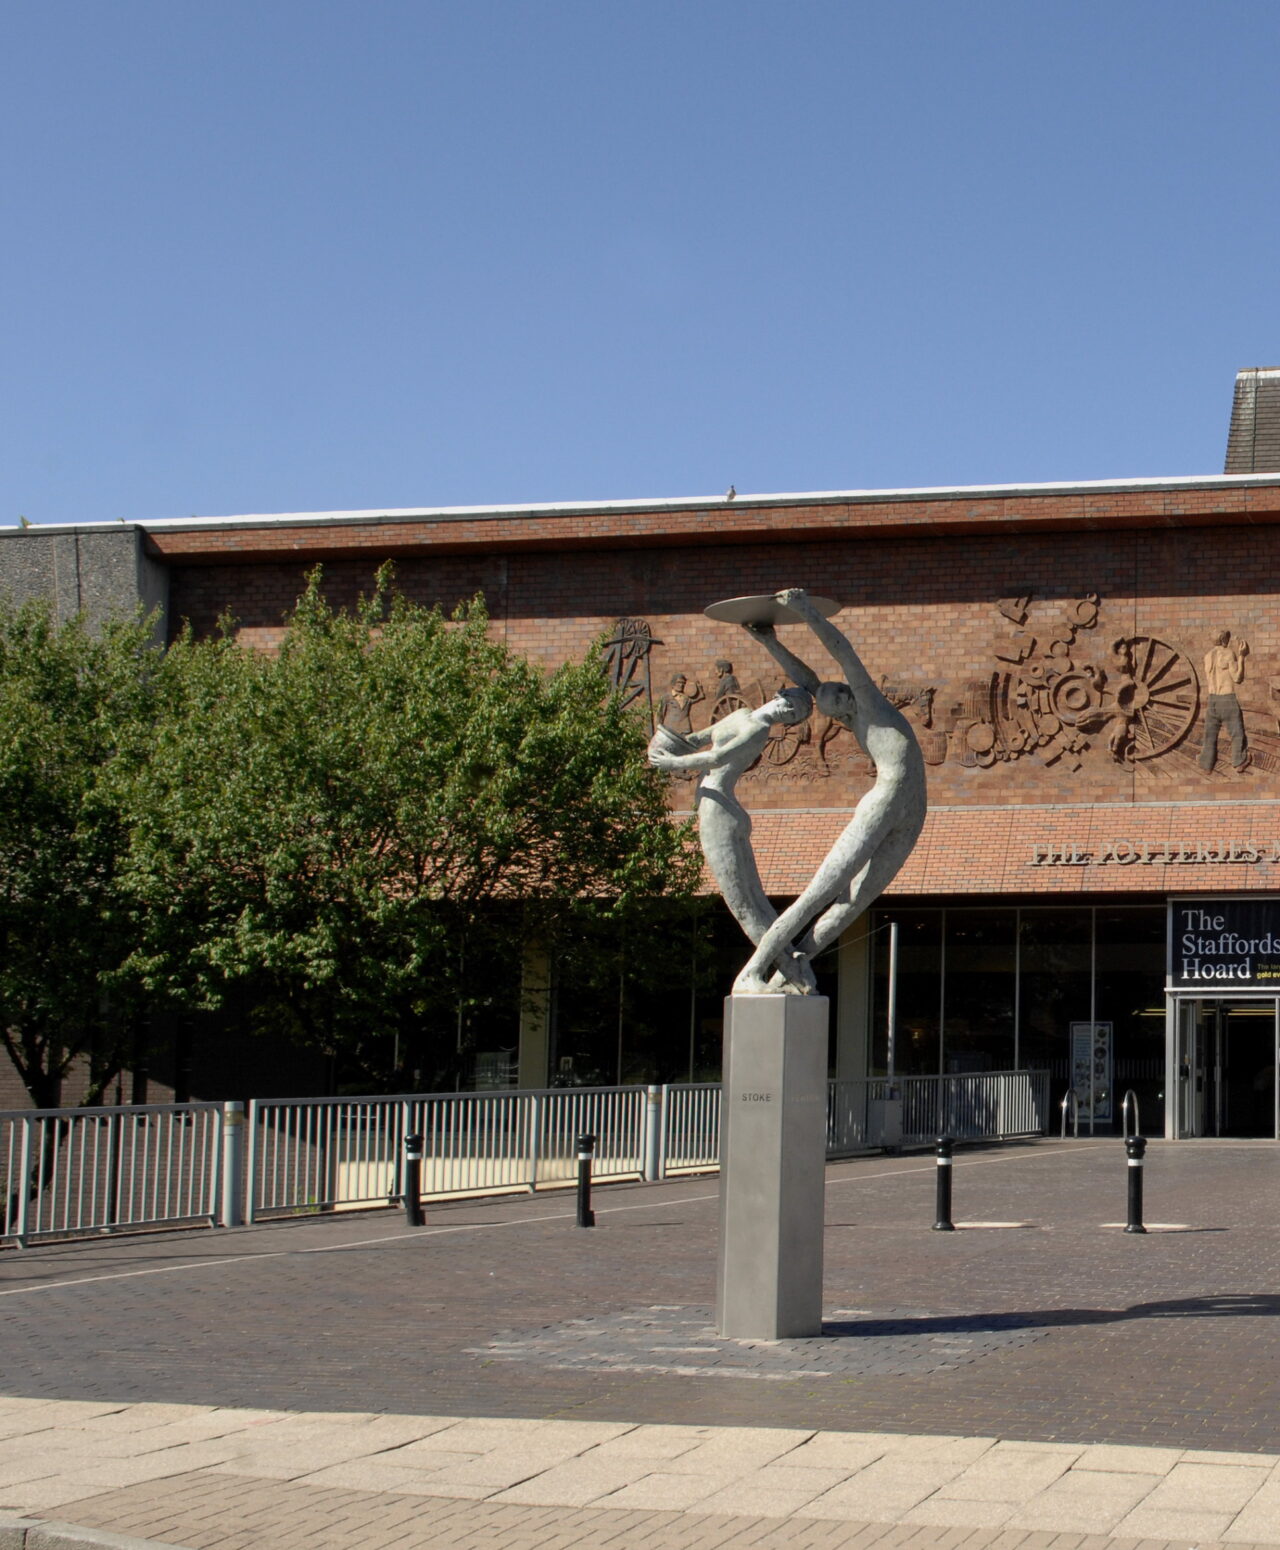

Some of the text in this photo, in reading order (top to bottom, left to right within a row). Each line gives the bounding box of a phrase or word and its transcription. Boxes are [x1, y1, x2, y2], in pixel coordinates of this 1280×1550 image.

[1031, 843, 1087, 865] THE
[1099, 839, 1259, 865] POTTERIES
[1182, 909, 1225, 931] The
[1181, 957, 1252, 980] Hoard
[1256, 971, 1272, 980] gold
[742, 1093, 771, 1101] STOKE
